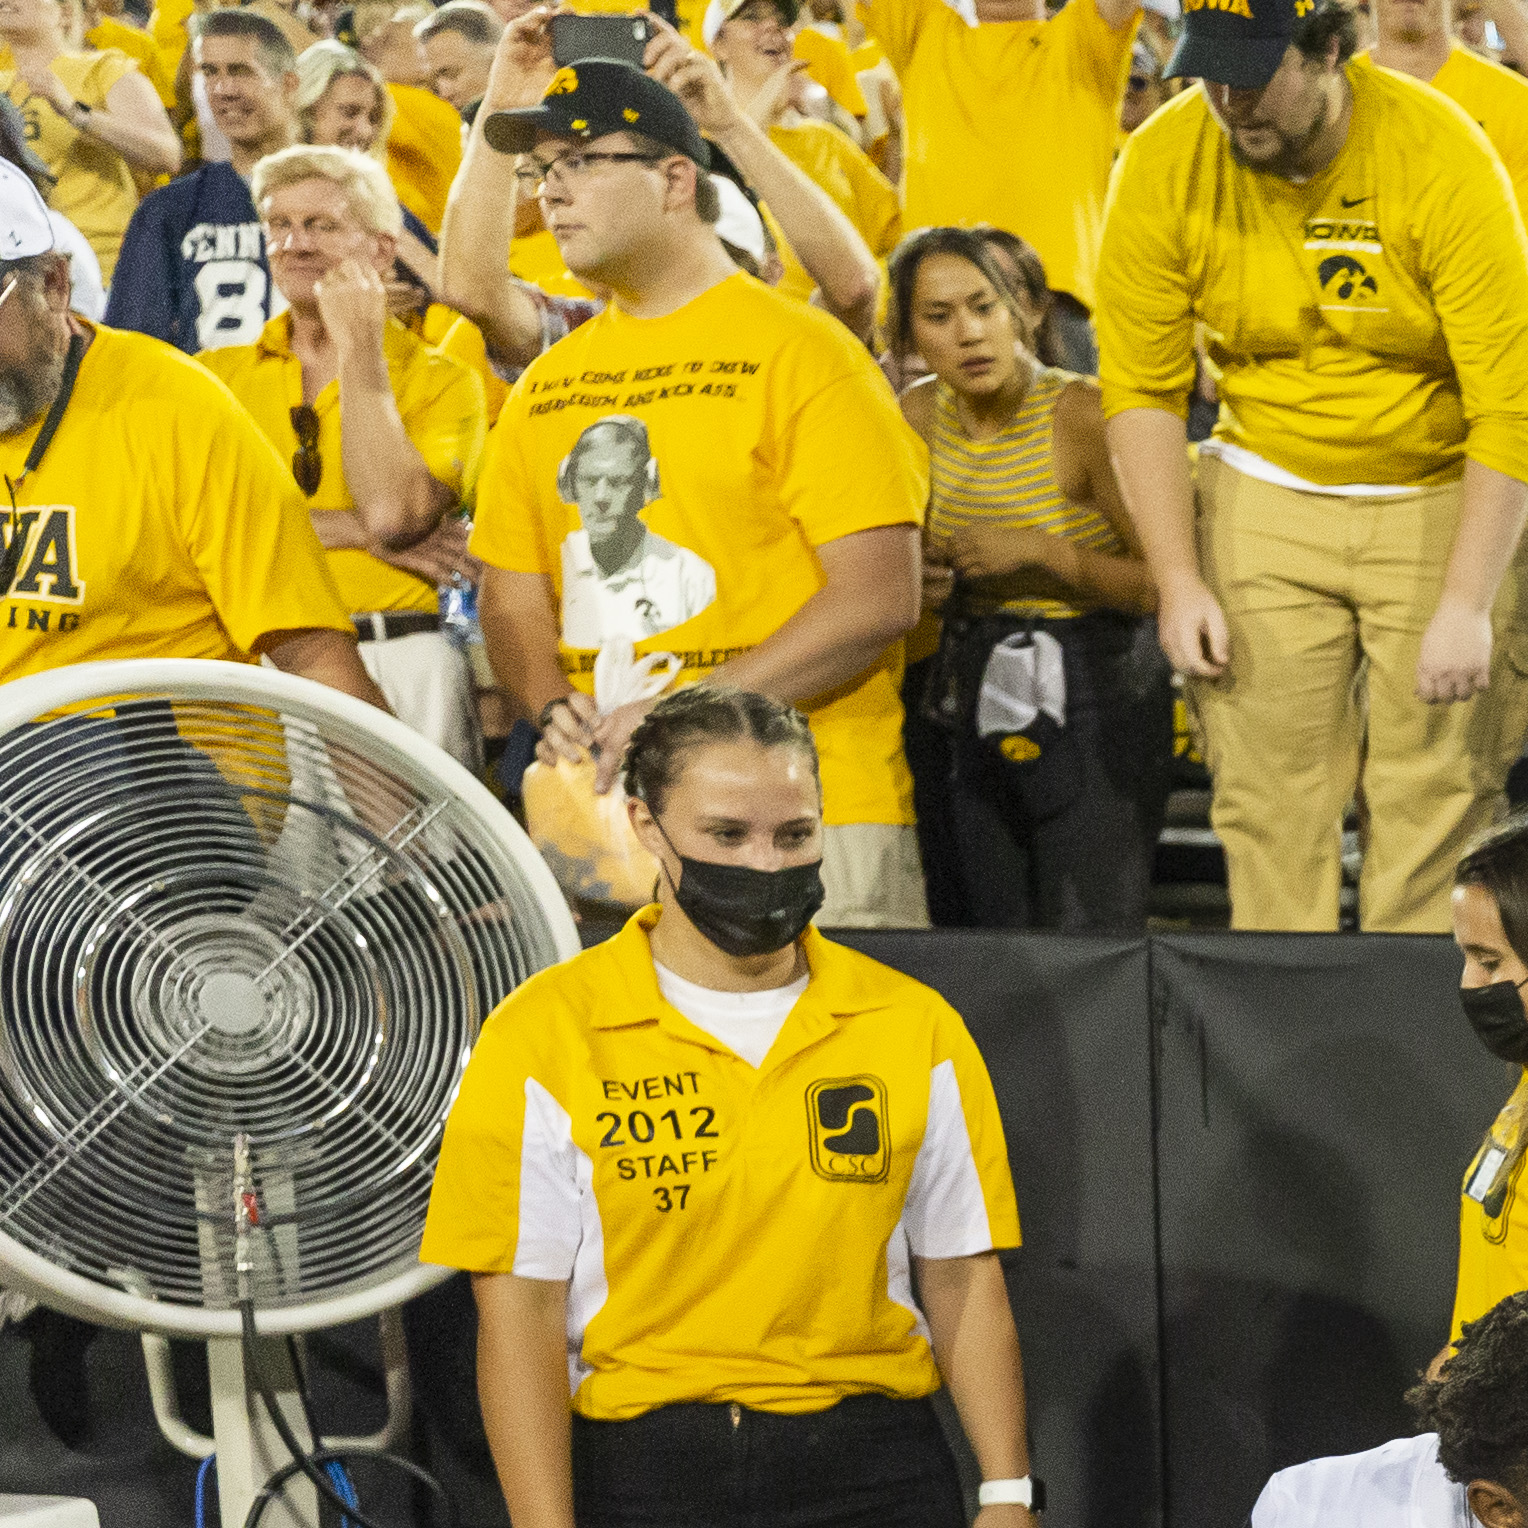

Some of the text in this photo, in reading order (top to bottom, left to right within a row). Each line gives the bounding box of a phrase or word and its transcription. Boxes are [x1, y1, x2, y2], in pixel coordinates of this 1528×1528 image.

[602, 1071, 701, 1101] EVENT
[596, 1106, 719, 1148] 2012
[616, 1150, 719, 1181] STAFF
[653, 1184, 692, 1213] 37
